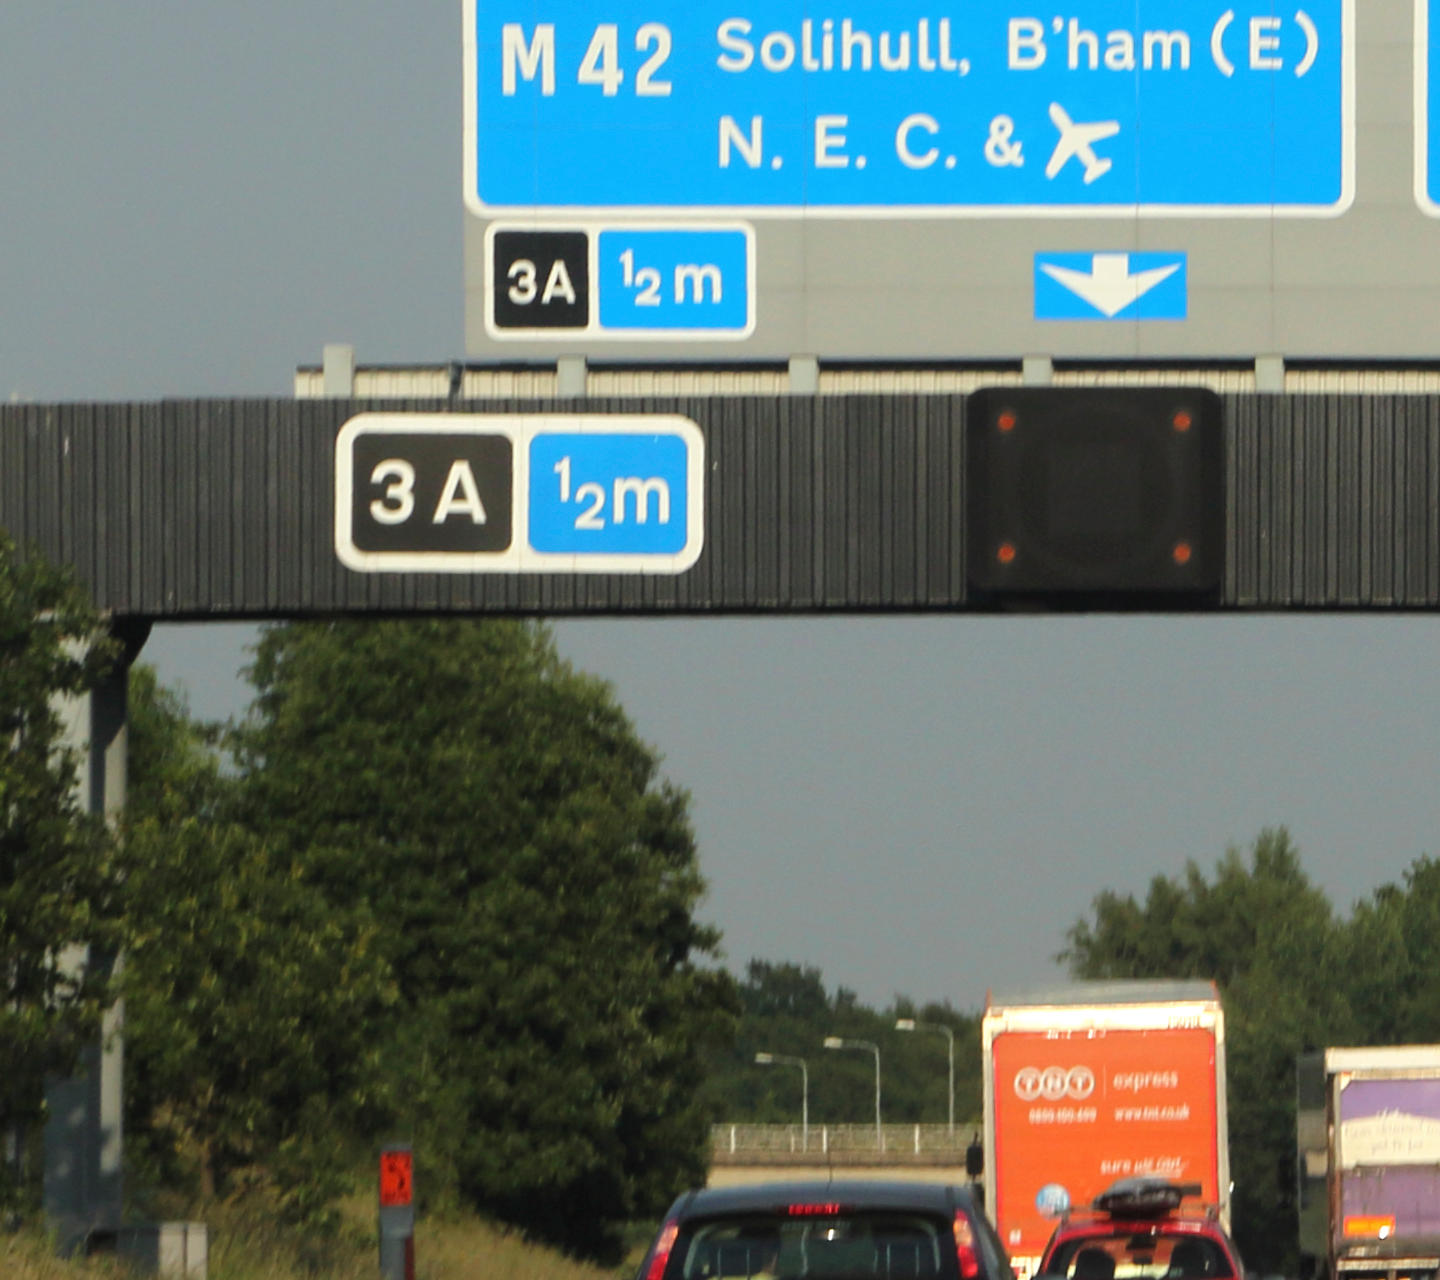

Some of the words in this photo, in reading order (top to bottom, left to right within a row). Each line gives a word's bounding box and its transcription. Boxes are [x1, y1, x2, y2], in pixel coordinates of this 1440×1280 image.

[715, 17, 971, 78] Solihull,
[1007, 16, 1192, 72] B'ham
[1210, 9, 1320, 79] (E)
[983, 114, 1026, 168] &
[507, 259, 576, 305] 3A
[1014, 1066, 1095, 1101] TNT
[1113, 1072, 1179, 1094] express
